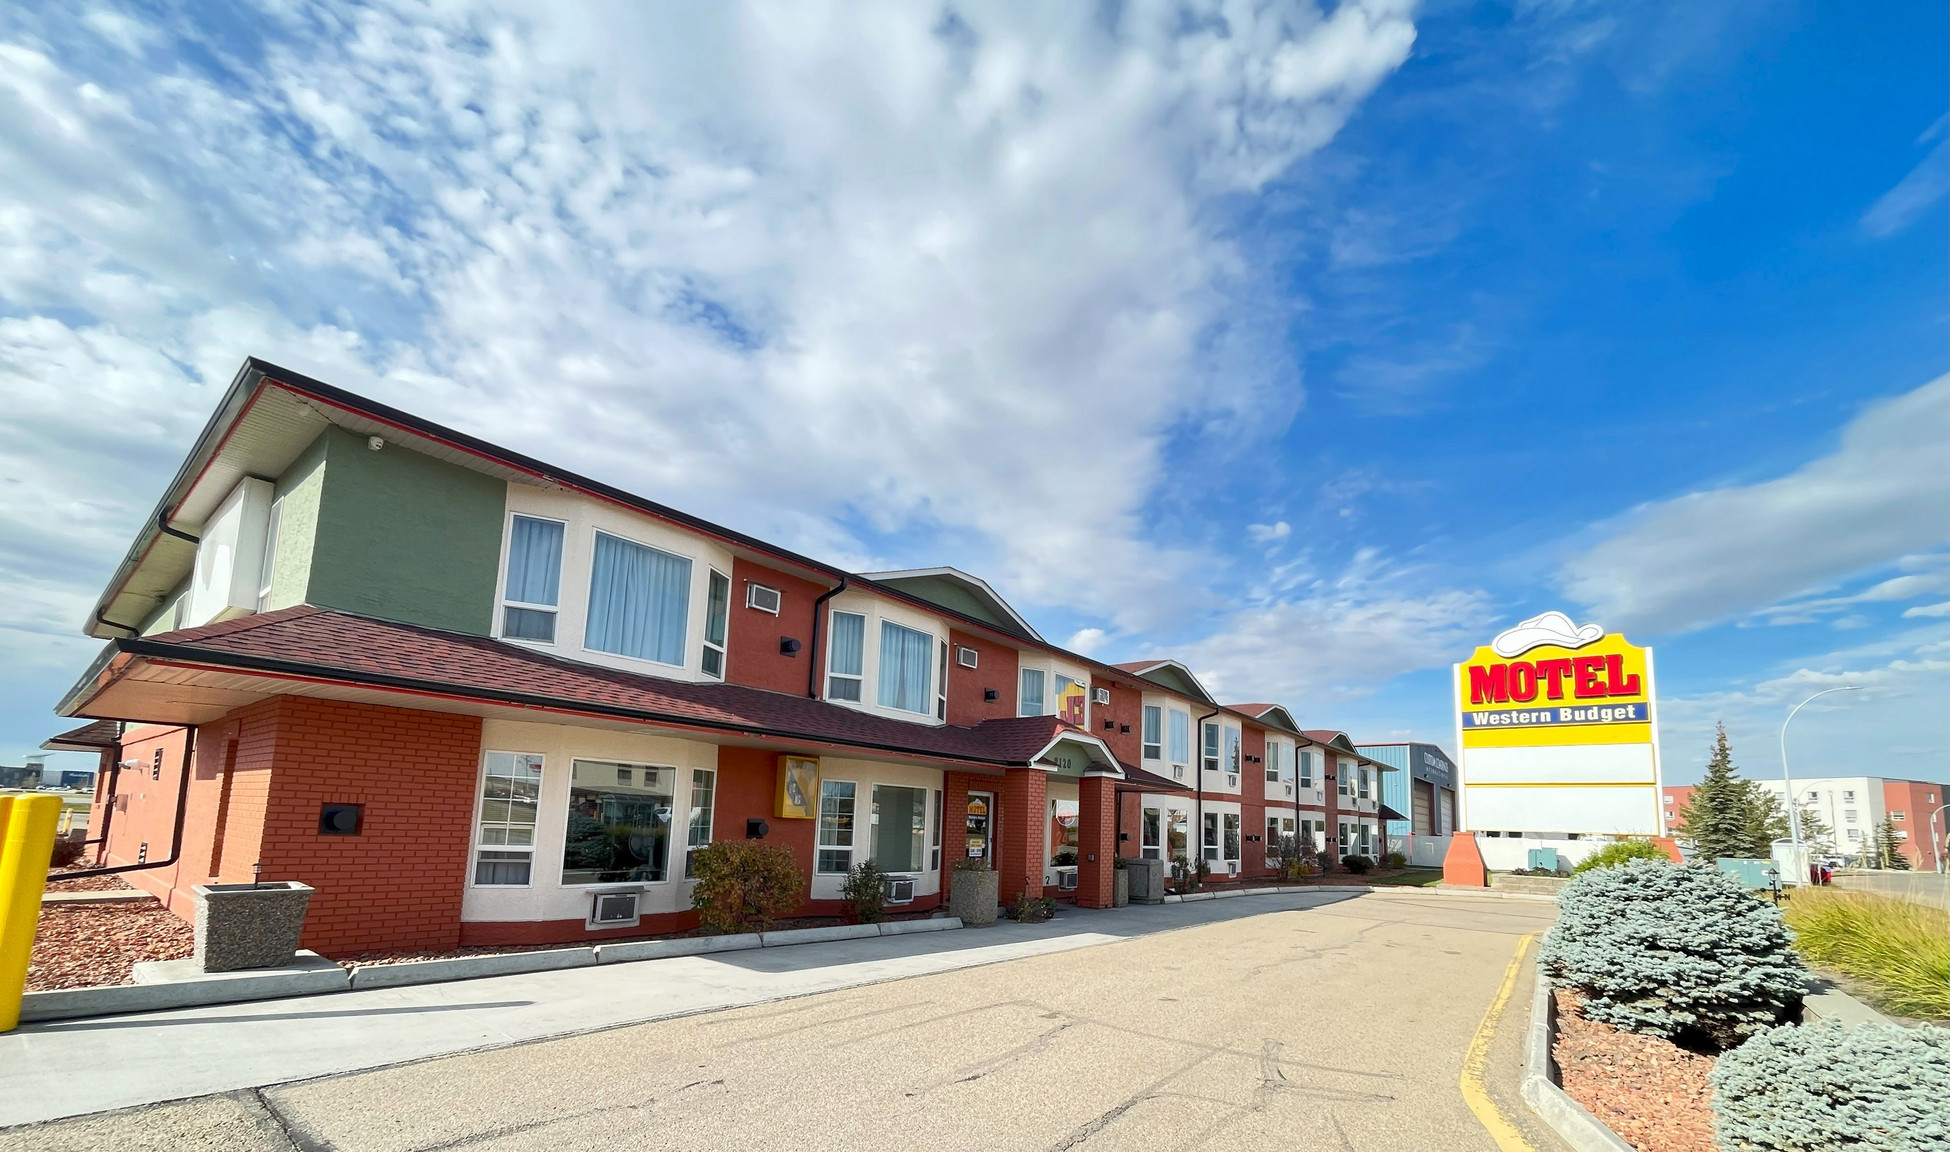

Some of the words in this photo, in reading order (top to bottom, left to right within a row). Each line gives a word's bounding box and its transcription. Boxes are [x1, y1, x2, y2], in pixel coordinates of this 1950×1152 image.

[1469, 654, 1641, 704] MOTEL
[1472, 710, 1551, 726] Western
[1559, 704, 1636, 722] Budget
